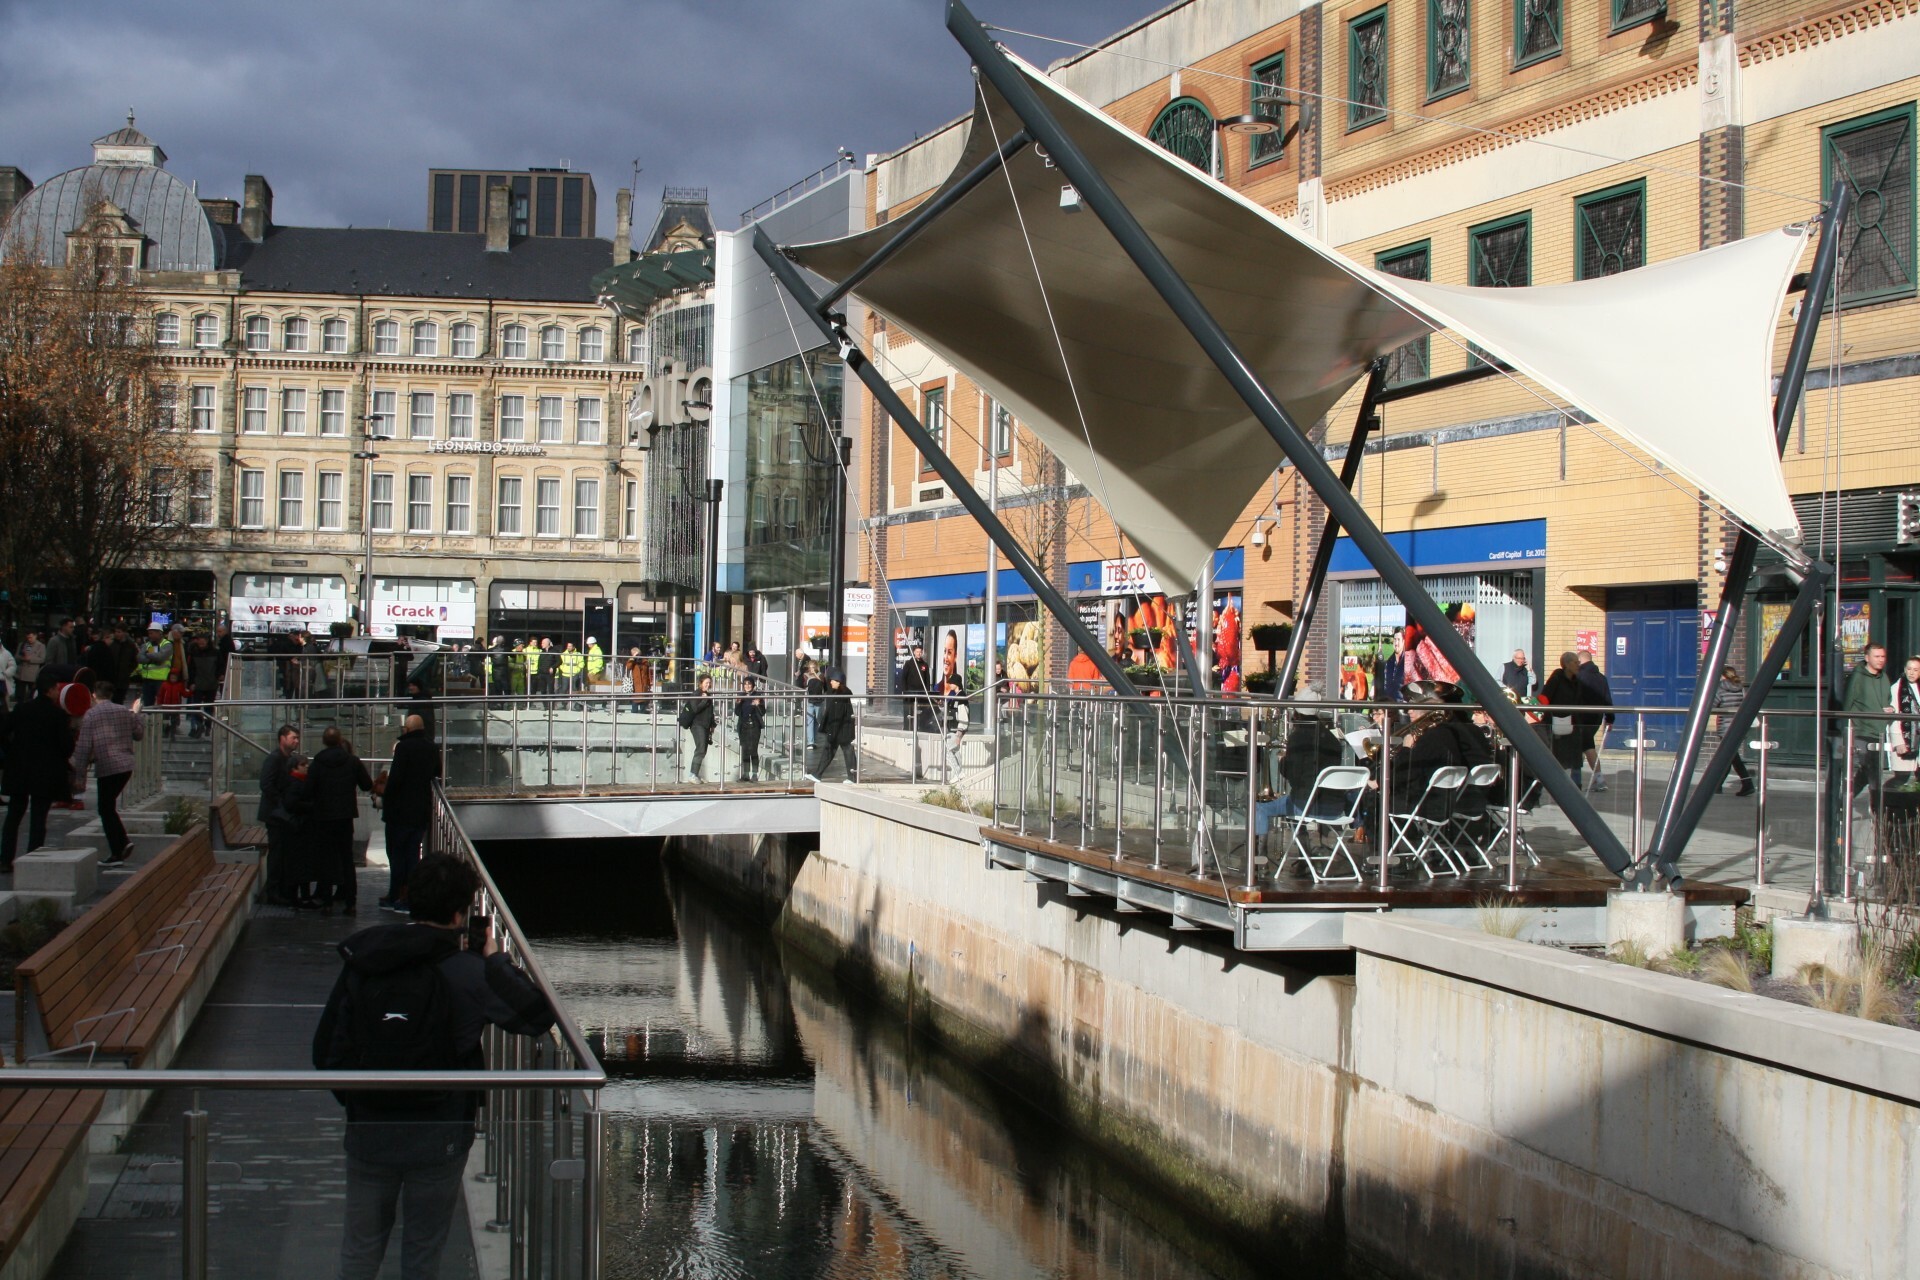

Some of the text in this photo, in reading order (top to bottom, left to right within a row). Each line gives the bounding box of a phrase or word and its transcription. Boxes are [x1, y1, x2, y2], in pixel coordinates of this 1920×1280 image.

[428, 439, 541, 453] LEONARDO Hotels
[1488, 551, 1505, 560] Cardiff
[1505, 550, 1522, 559] Capitol
[1105, 562, 1147, 583] TESCO
[847, 592, 872, 600] TESCO
[249, 605, 317, 616] VAPE SHOP
[387, 604, 435, 618] iCrack
[1576, 636, 1587, 644] Dry
